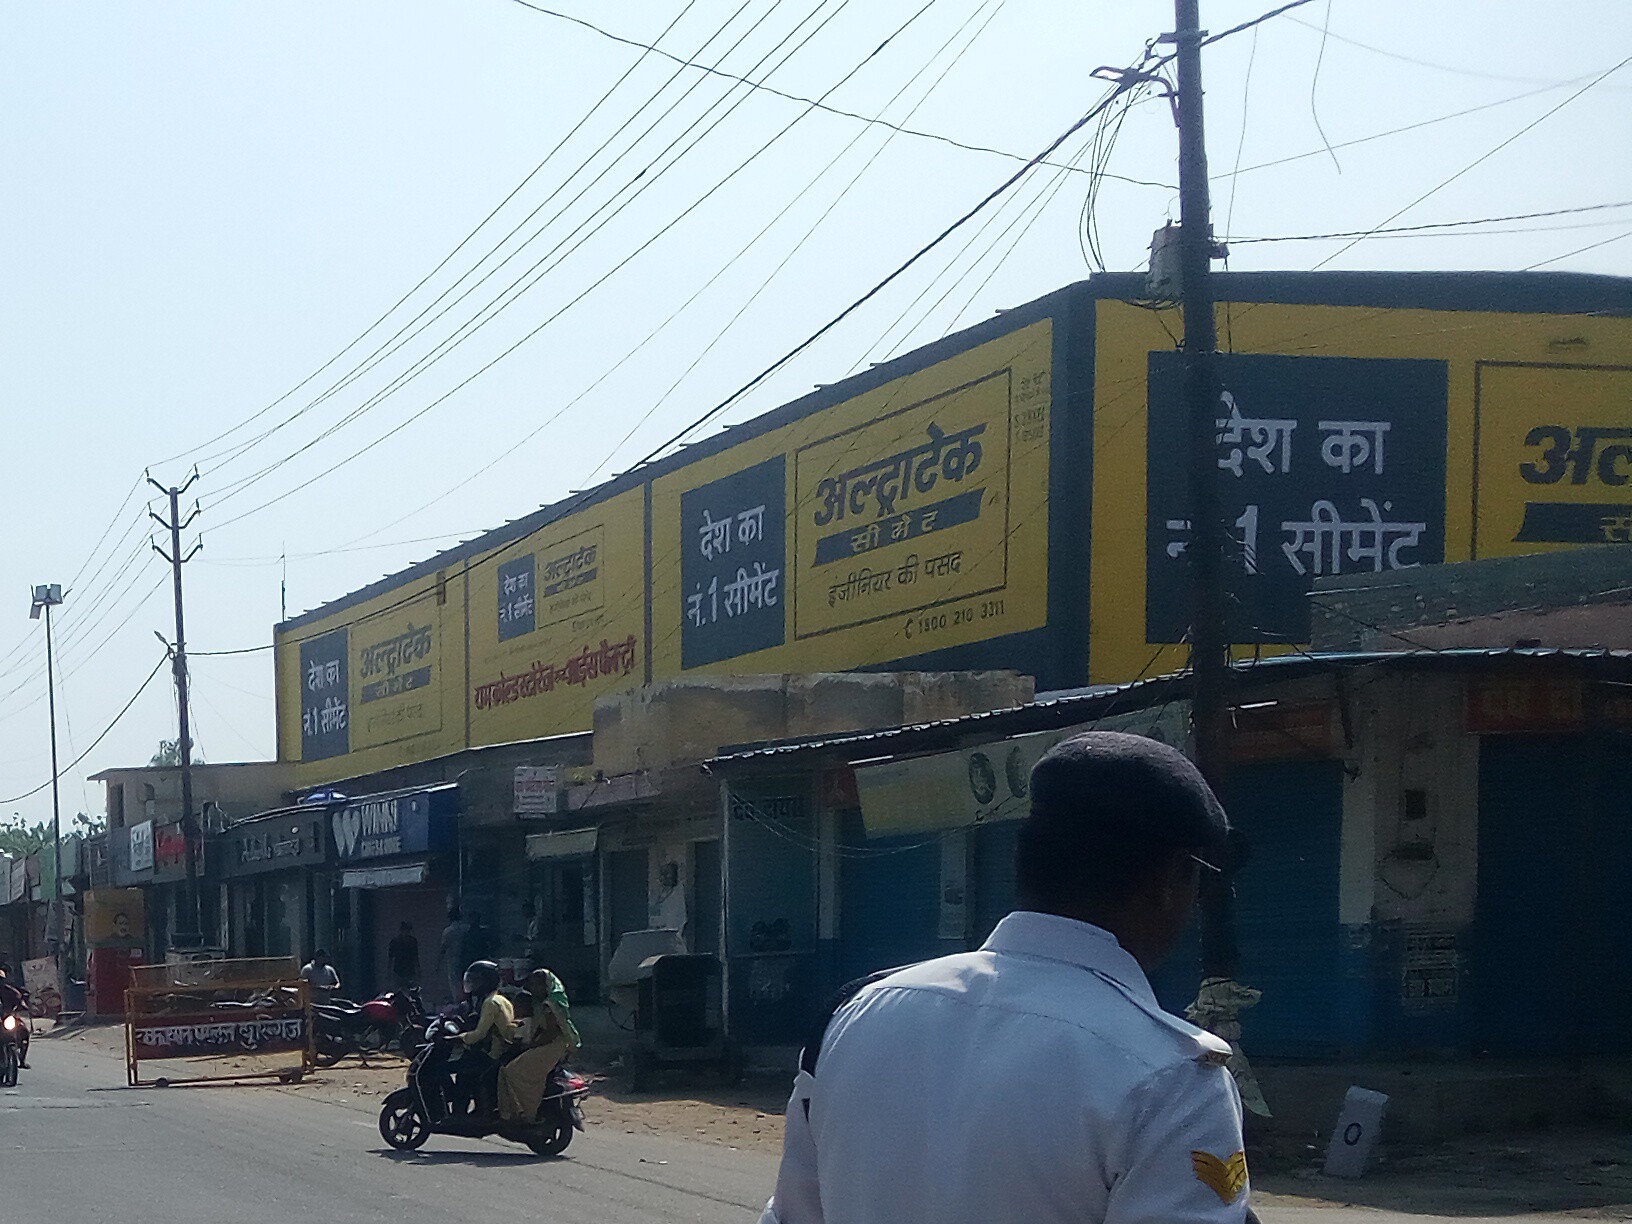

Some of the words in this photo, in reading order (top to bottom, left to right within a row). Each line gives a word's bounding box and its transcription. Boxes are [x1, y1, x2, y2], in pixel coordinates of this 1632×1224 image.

[813, 420, 989, 526] अल्ट्राटेक
[1317, 419, 1392, 475] का
[699, 508, 731, 561] देश
[737, 503, 767, 544] का
[1280, 497, 1427, 576] सीमेंट
[723, 560, 780, 620] सीमेंट
[896, 553, 919, 590] की
[952, 607, 974, 630] 210
